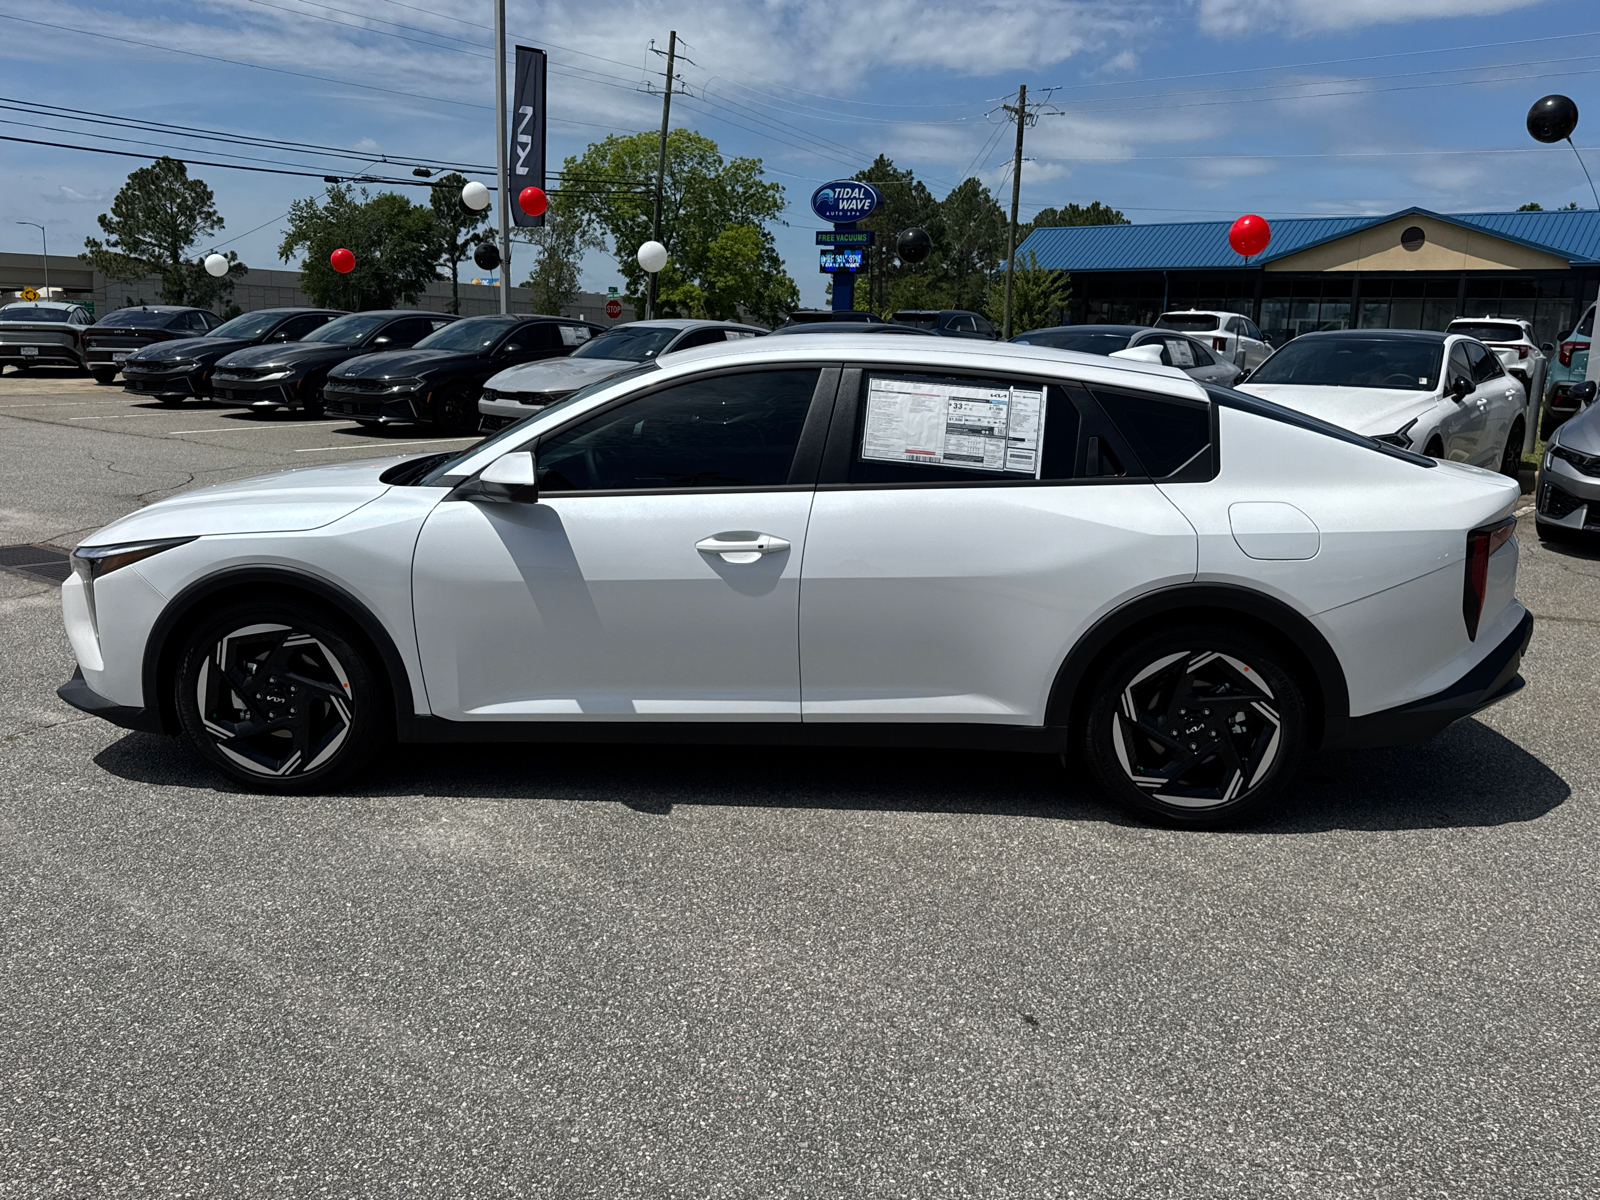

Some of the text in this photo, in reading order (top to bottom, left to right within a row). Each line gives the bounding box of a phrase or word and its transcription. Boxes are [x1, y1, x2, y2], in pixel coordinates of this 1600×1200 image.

[834, 188, 865, 199] TIDAL
[839, 199, 871, 210] WAVE
[818, 233, 867, 242] FREE VACUUMS
[606, 305, 621, 314] STOP
[953, 402, 963, 410] 33
[1186, 723, 1204, 734] KIA
